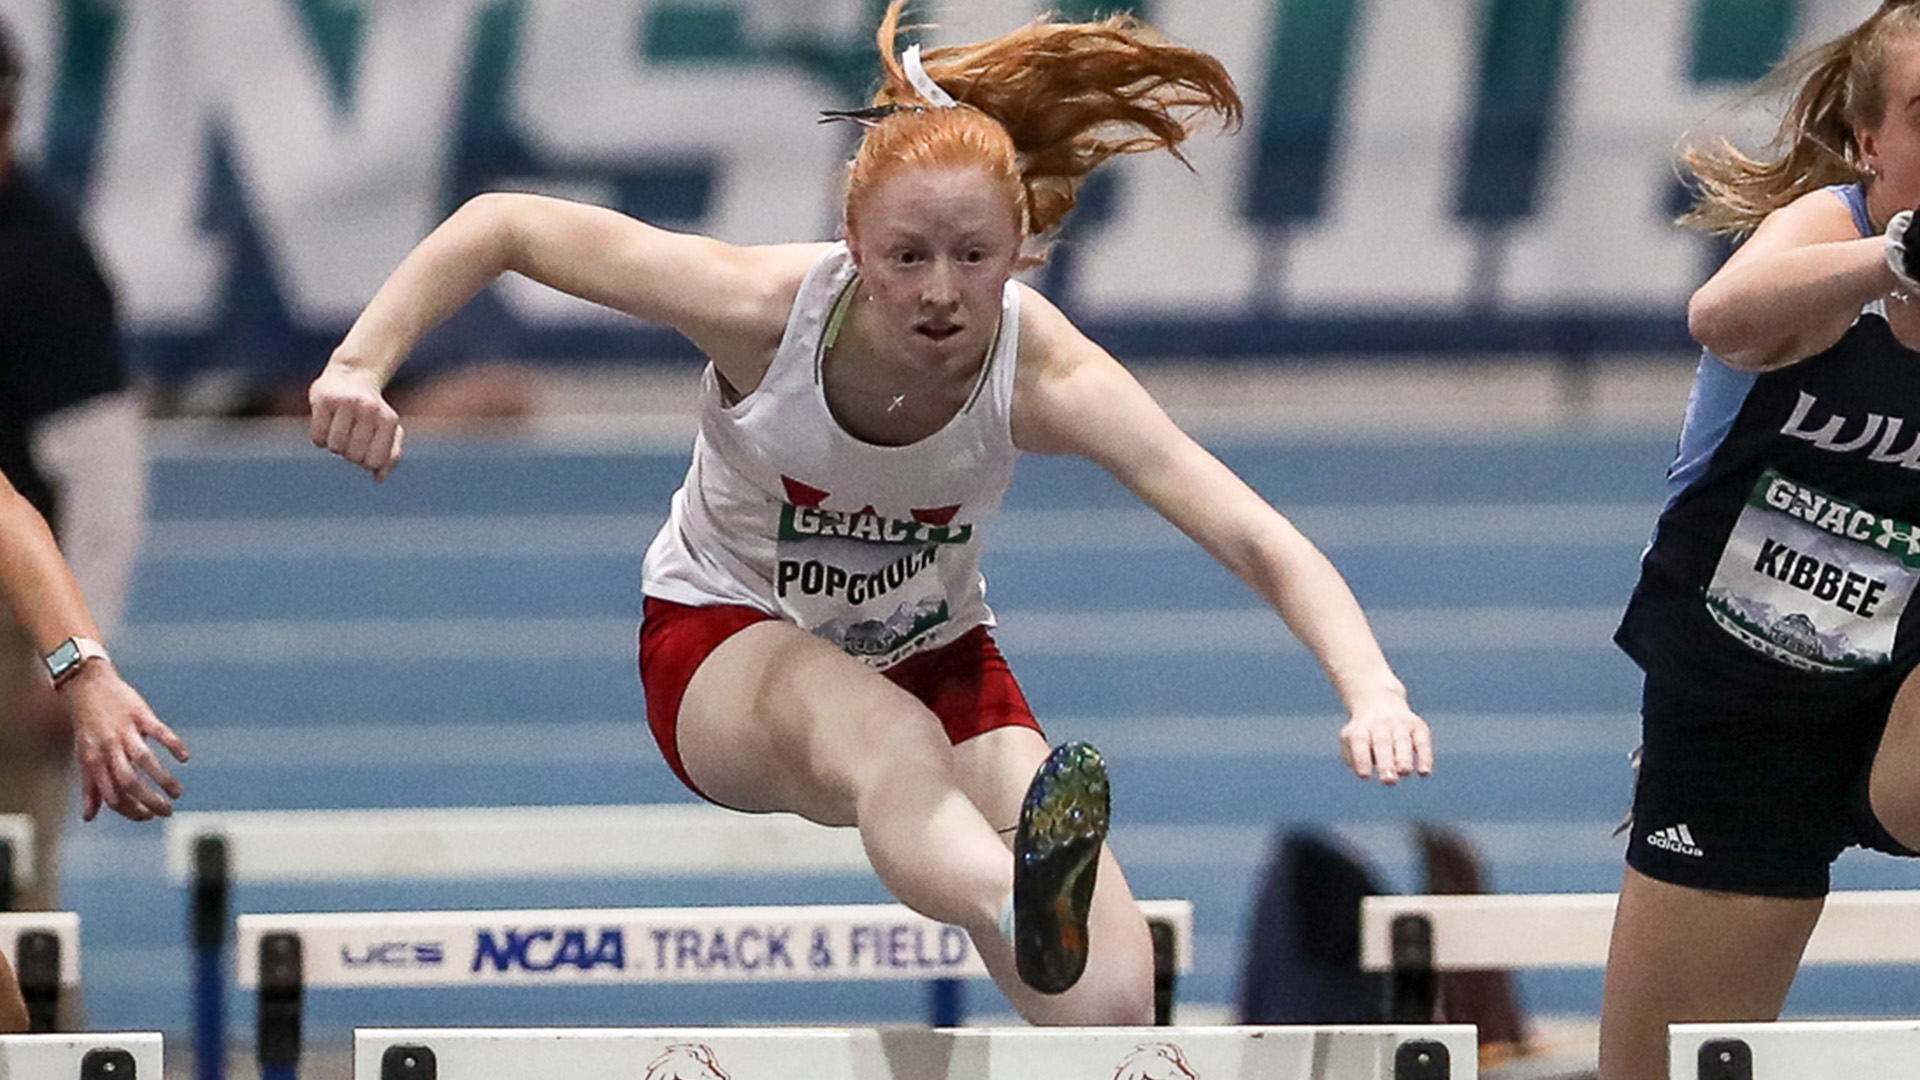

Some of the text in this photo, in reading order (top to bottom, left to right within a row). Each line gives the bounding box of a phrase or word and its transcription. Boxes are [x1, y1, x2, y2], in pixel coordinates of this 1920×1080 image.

[793, 505, 909, 542] GNAC
[1765, 477, 1876, 541] GNAC
[1753, 537, 1888, 619] KIBBEE
[1646, 834, 1704, 857] adidas
[341, 924, 970, 974] UCS NCAA TRACK & FIELD
